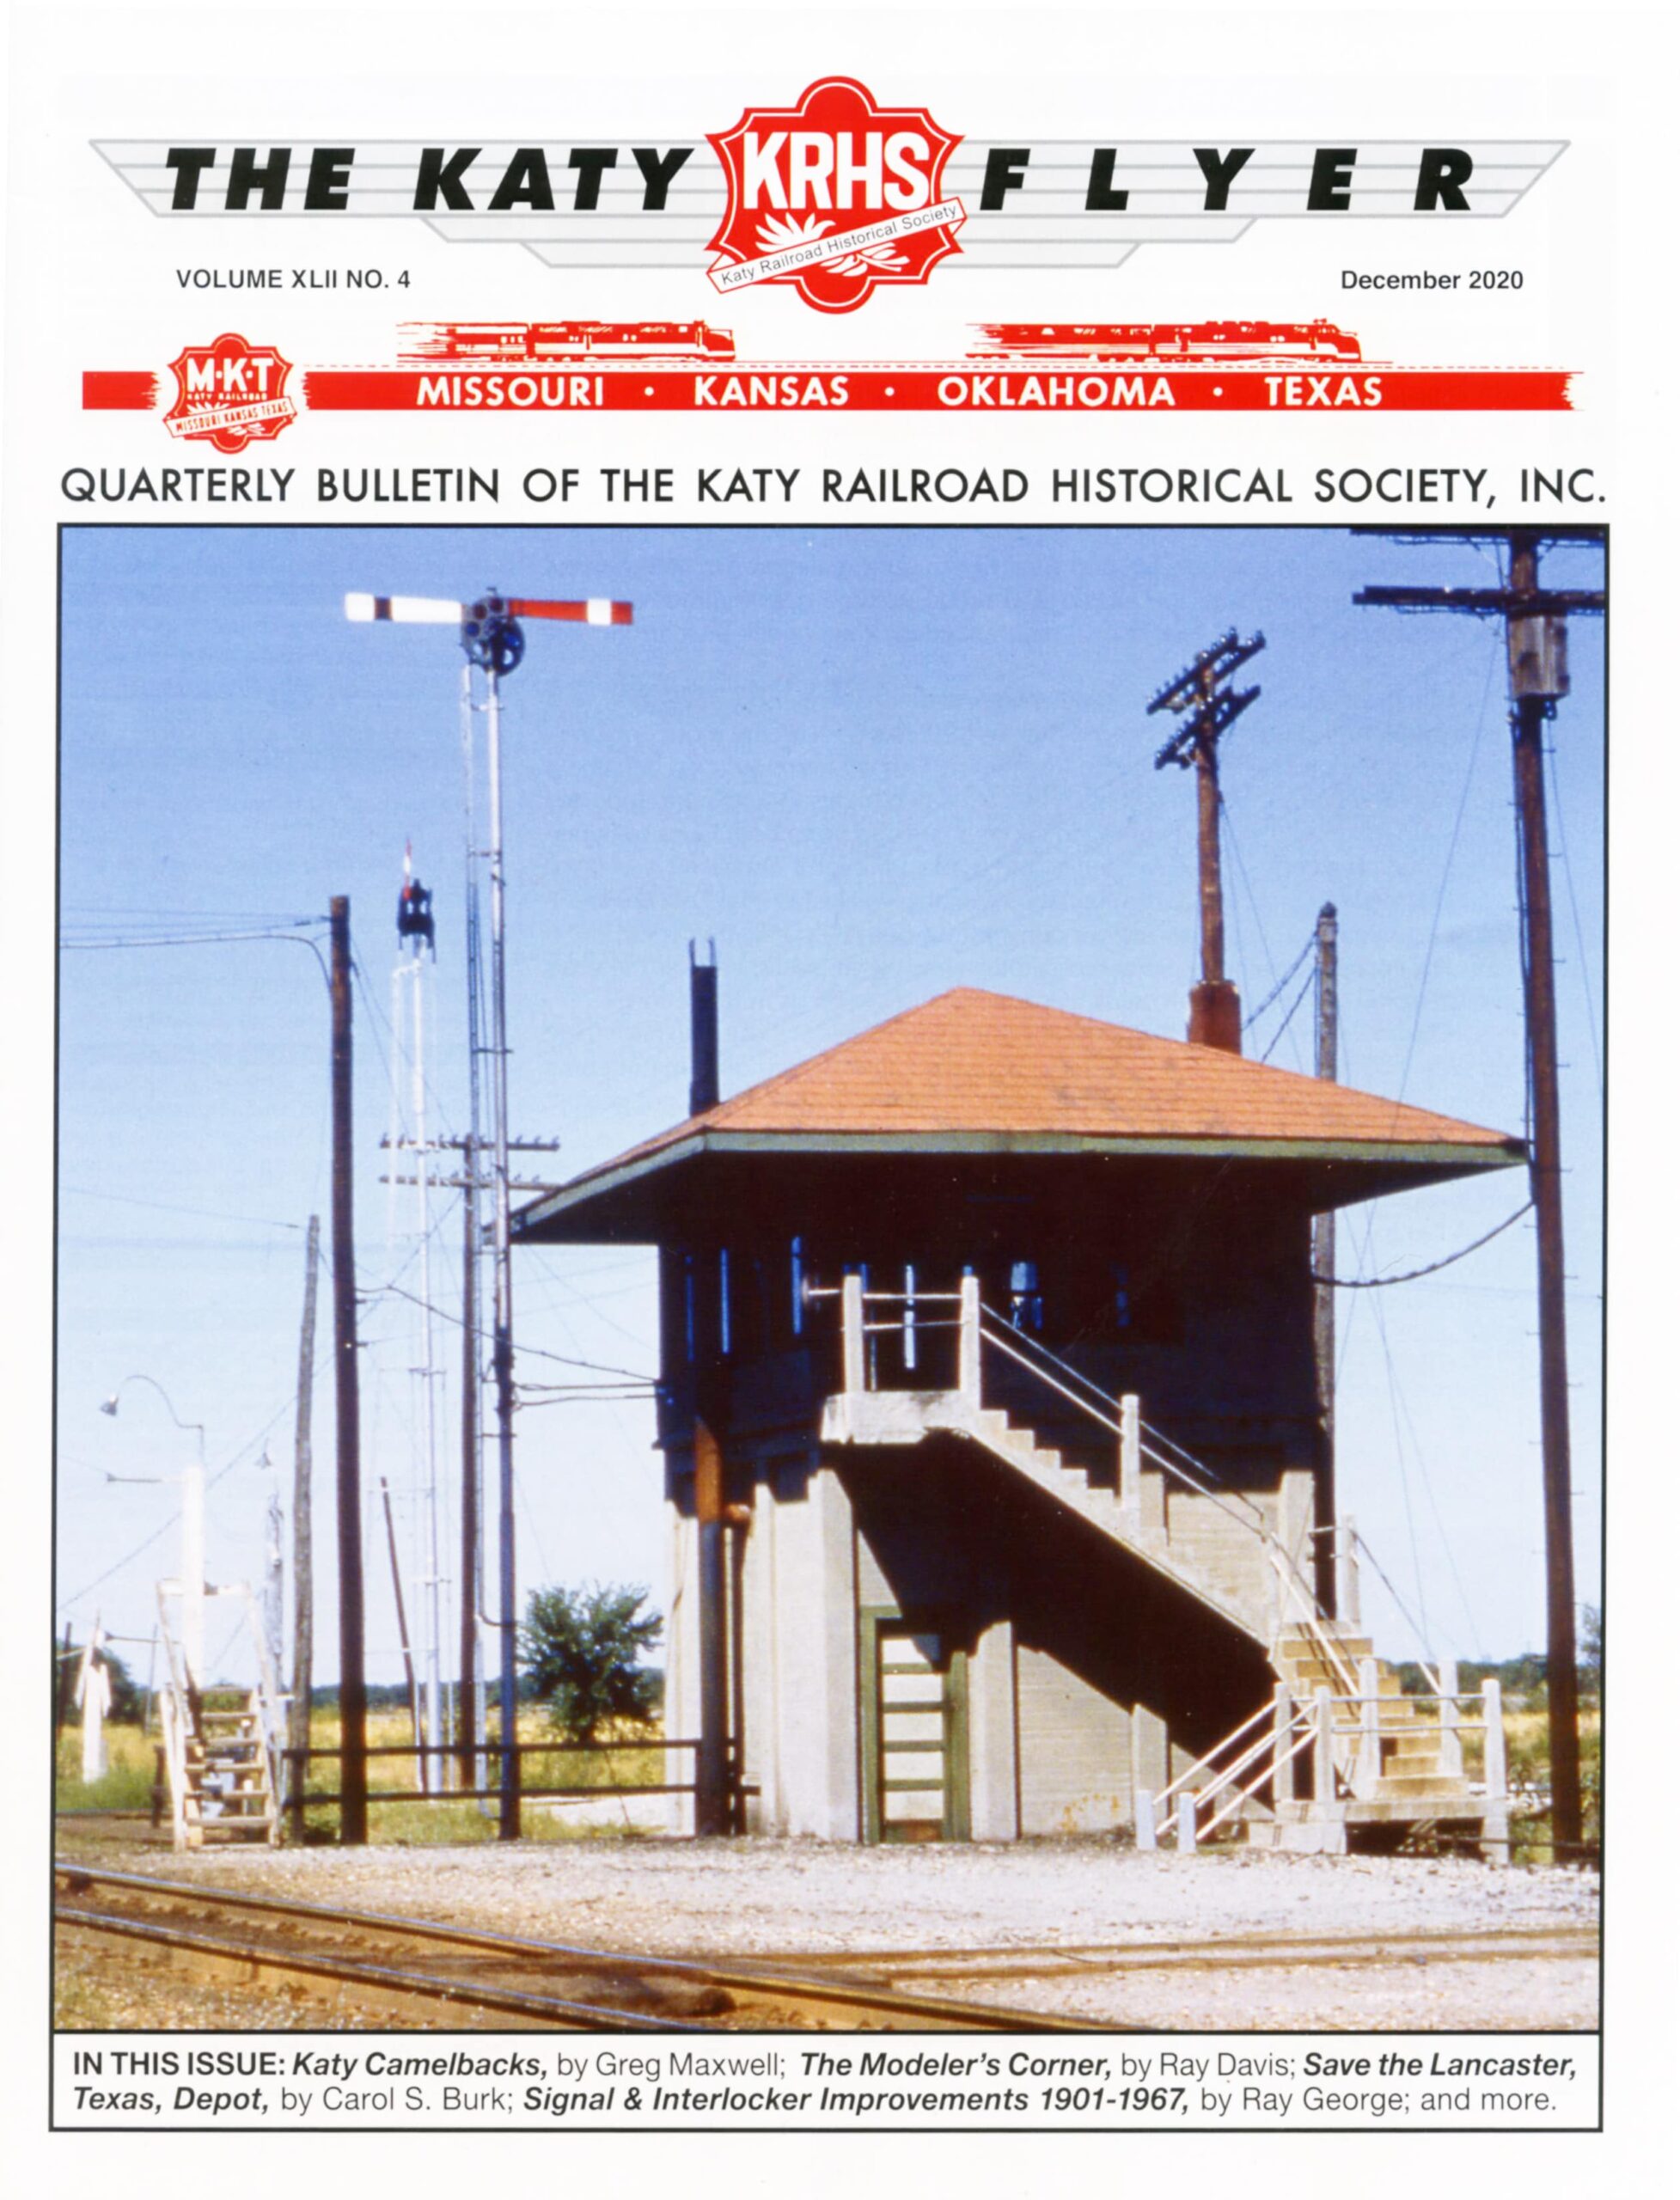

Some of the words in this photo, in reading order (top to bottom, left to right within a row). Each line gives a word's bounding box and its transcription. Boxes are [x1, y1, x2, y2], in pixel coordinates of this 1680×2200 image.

[165, 148, 355, 211] THE
[412, 148, 695, 211] KATY
[979, 148, 1474, 211] FLYER
[742, 131, 931, 211] KRHS
[720, 267, 755, 285] Katy
[760, 244, 824, 273] Railroad
[826, 222, 898, 254] Historical
[901, 205, 957, 230] Society
[176, 269, 282, 289] VOLUME
[292, 269, 337, 289] XLII
[345, 269, 393, 289] NO.
[397, 269, 411, 289] 4
[1341, 270, 1462, 290] December
[1469, 270, 1524, 290] 2020
[416, 376, 604, 407] MISSOURI
[693, 376, 850, 407] KANSAS
[937, 376, 1176, 408] OKLAHOMA
[1264, 376, 1383, 407] TEXAS
[175, 415, 221, 432] MISSOURI
[224, 407, 259, 424] KANSAS
[261, 401, 290, 416] TEXAS
[61, 468, 295, 502] QUARTERLY
[318, 468, 498, 503] BULLETIN
[523, 468, 579, 503] OF
[600, 468, 674, 502] THE
[698, 468, 800, 502] KATY
[823, 468, 1029, 503] RAILROAD
[1053, 468, 1292, 503] HISTORICAL
[1315, 468, 1495, 509] SOCIETY,
[1521, 468, 1605, 503] INC.
[73, 2051, 103, 2075] IN
[110, 2051, 180, 2075] THIS
[188, 2051, 284, 2075] ISSUE:
[292, 2052, 358, 2081] Katy
[365, 2051, 547, 2080] Camelbacks,
[557, 2052, 588, 2081] by
[596, 2051, 660, 2082] Greg
[669, 2052, 786, 2080] Maxwell;
[801, 2052, 852, 2076] The
[1009, 2052, 1110, 2081] Corner,
[1121, 2052, 1152, 2082] by
[1160, 2052, 1209, 2081] Ray
[1218, 2052, 1296, 2080] Davis;
[1304, 2052, 1371, 2076] Save
[1379, 2052, 1423, 2076] the
[1430, 2052, 1577, 2081] Lancaster,
[74, 2087, 163, 2113] Texas,
[174, 2087, 270, 2115] Depot,
[281, 2087, 312, 2116] by
[322, 2087, 394, 2111] Carol
[405, 2087, 431, 2111] S.
[443, 2087, 513, 2114] Burk;
[523, 2087, 614, 2116] Signal
[624, 2087, 642, 2111] &
[653, 2087, 812, 2111] Interlocker
[820, 2087, 1029, 2116] Improvements
[1042, 2087, 1190, 2114] 1901-1967,
[1201, 2087, 1231, 2117] by
[1243, 2087, 1292, 2117] Ray
[1303, 2087, 1410, 2117] George;
[1420, 2087, 1469, 2111] and
[1481, 2093, 1557, 2111] more.
